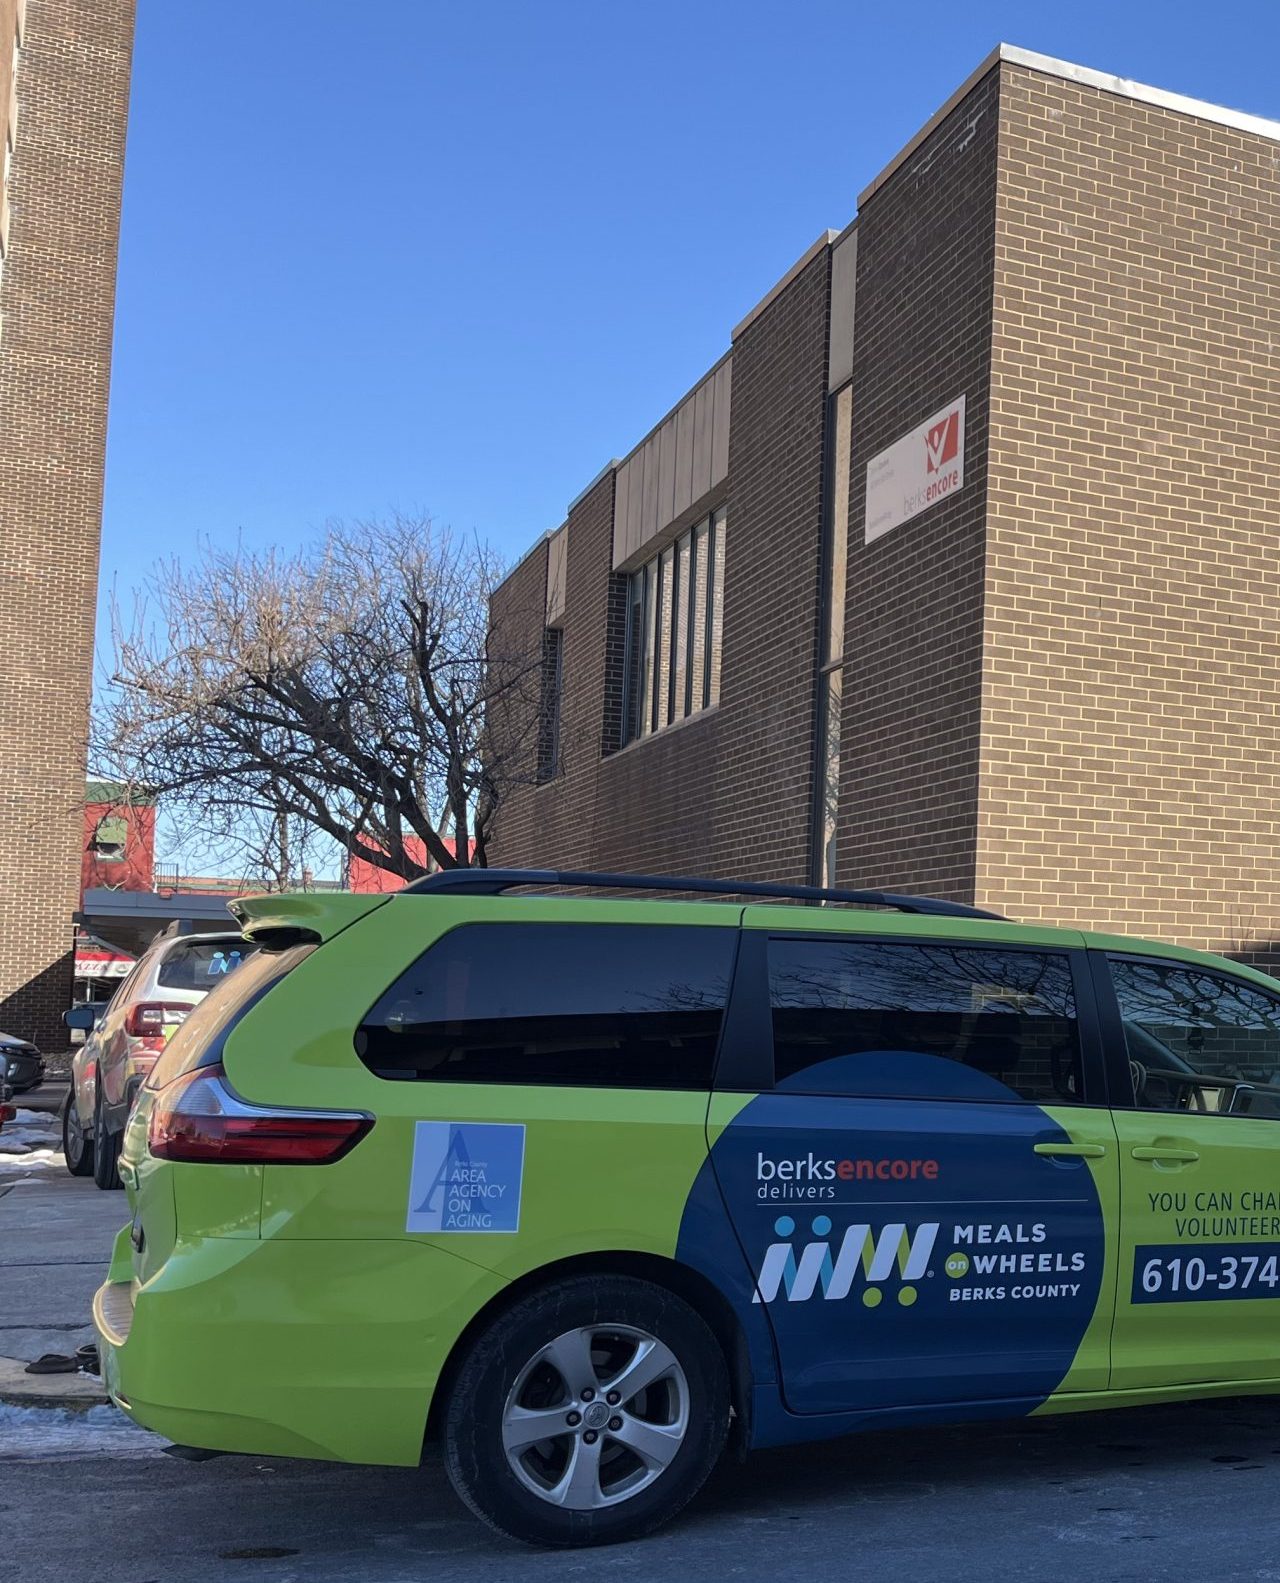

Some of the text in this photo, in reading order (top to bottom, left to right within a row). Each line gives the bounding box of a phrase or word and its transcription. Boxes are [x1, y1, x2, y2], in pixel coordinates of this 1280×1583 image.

[451, 1169, 486, 1183] AREA
[449, 1184, 506, 1198] AGENCY
[757, 1183, 836, 1199] delivers
[448, 1199, 471, 1212] ON
[1148, 1191, 1186, 1213] YOU
[1195, 1191, 1233, 1212] CAN
[446, 1213, 492, 1228] AGING
[1175, 1216, 1280, 1238] VOLUNTEER
[953, 1223, 1047, 1244] MEALS
[947, 1252, 1086, 1274] on WHEELS
[949, 1283, 1081, 1302] BERKS COUNTY
